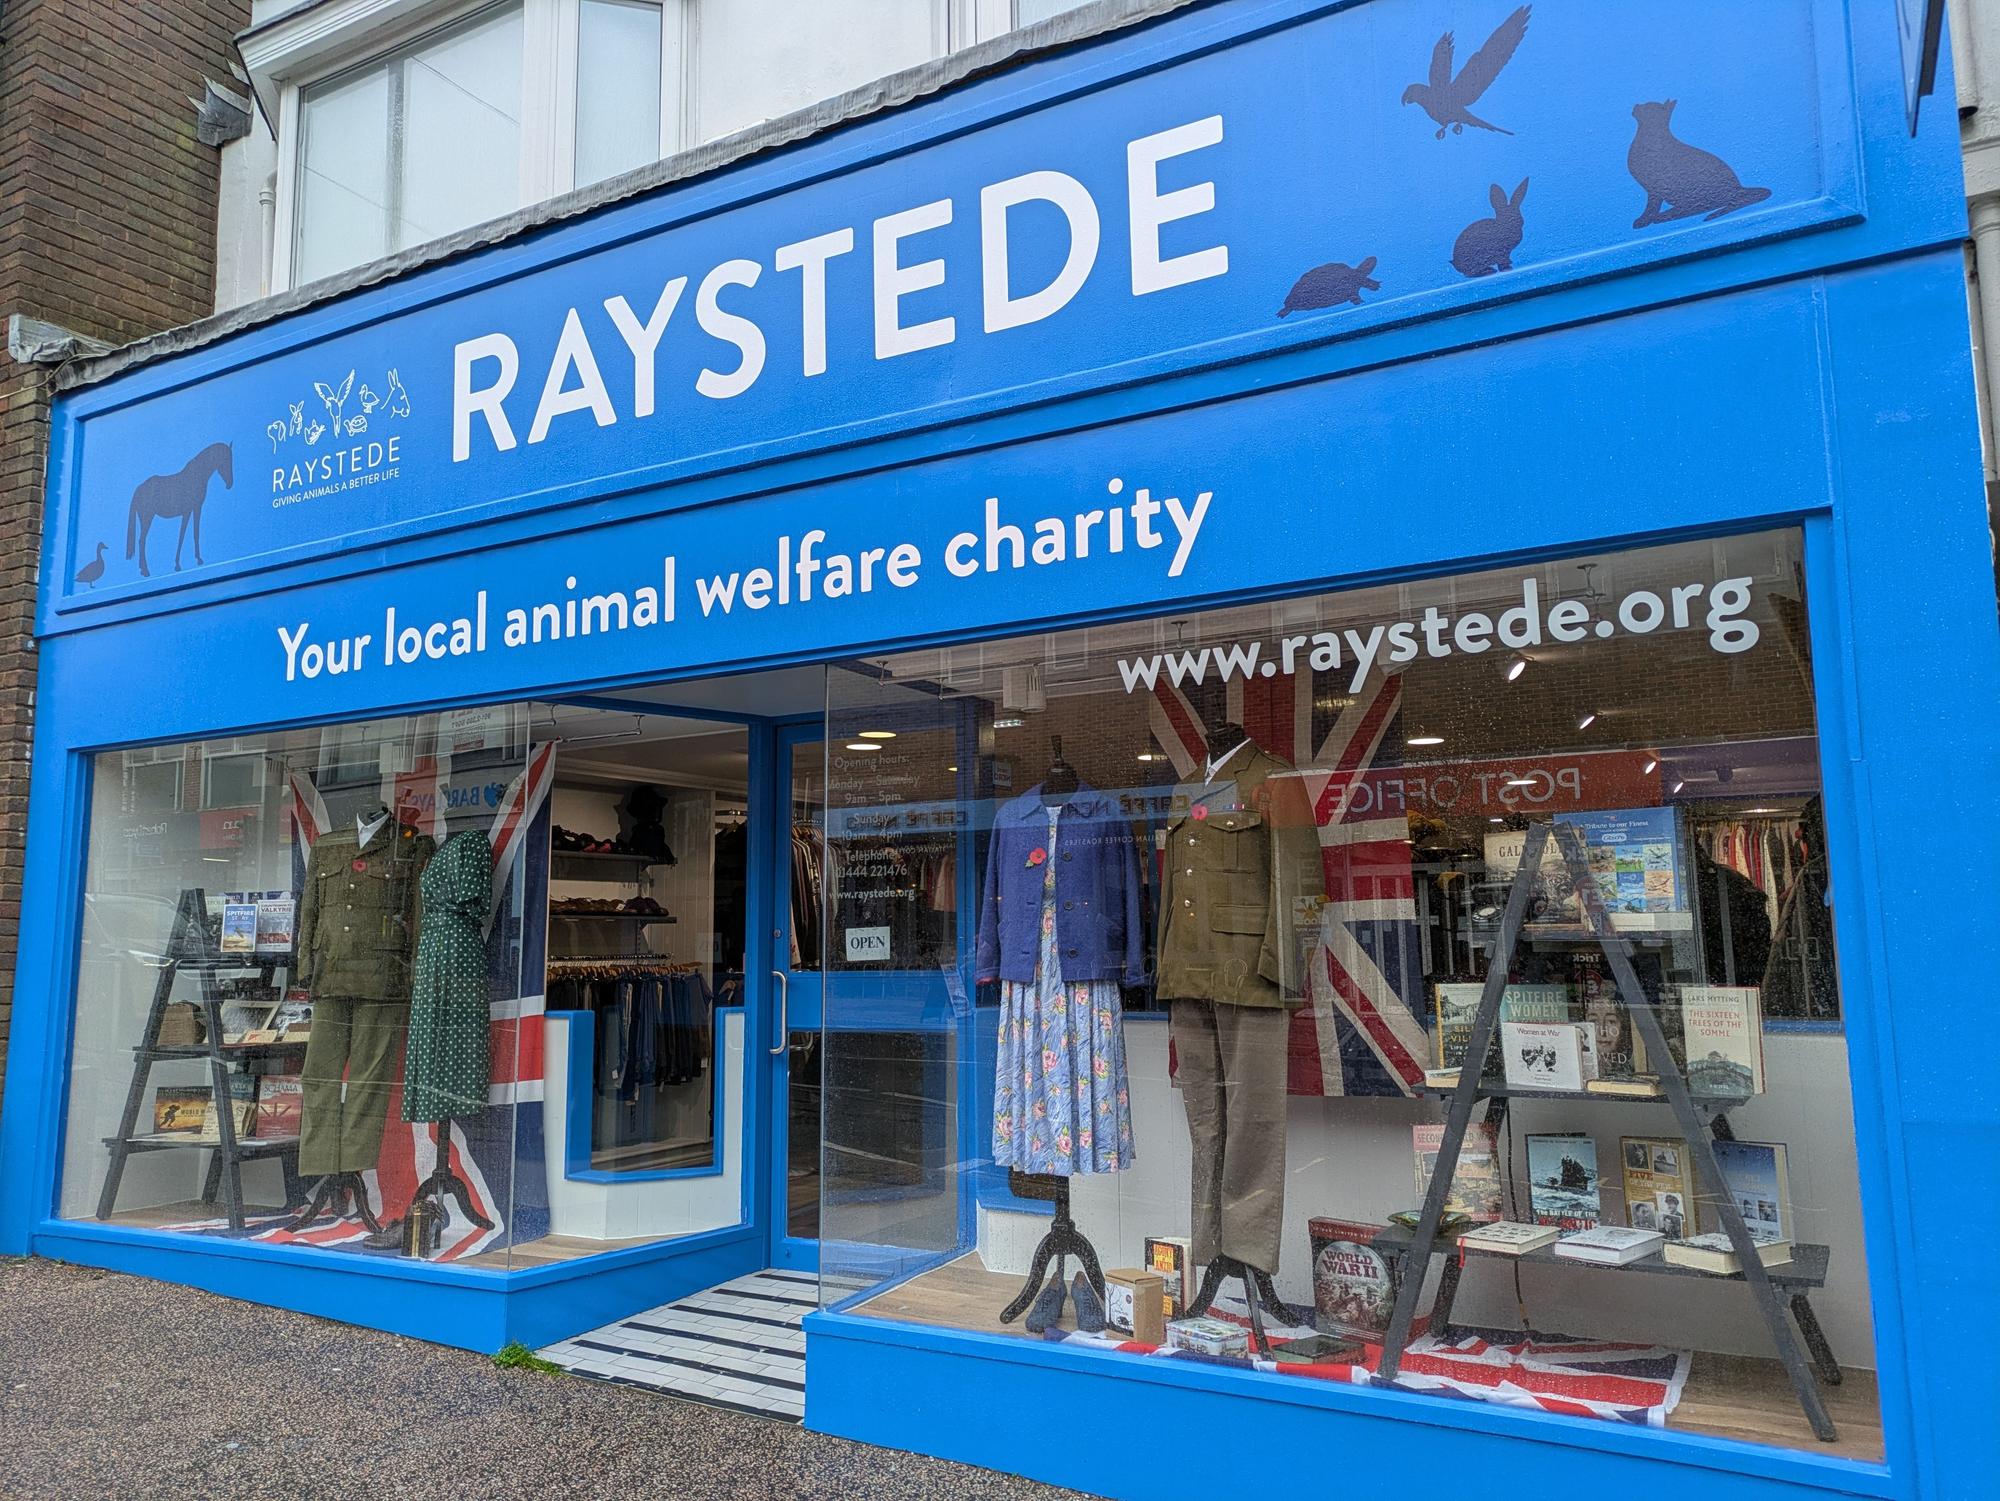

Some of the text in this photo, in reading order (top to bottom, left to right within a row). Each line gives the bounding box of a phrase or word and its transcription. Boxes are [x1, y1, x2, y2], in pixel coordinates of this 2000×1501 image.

[453, 115, 1229, 462] RAYSTEDE
[273, 436, 400, 492] RAYSTEDE
[272, 468, 399, 508] GIVING ANIMALS A BETTER LIFE
[278, 478, 1213, 681] Your local animal welfare charity
[1117, 577, 1760, 694] www.raystede.org
[835, 755, 911, 771] Opening hours:
[845, 793, 867, 803] 9am
[879, 791, 901, 805] 5pm
[853, 812, 890, 826] Sunday
[880, 828, 902, 843] 4pm
[871, 864, 907, 877] 221476
[829, 886, 915, 902] www.raystede.org
[850, 936, 886, 950] OPEN
[1504, 991, 1562, 1004] SPITFIRE
[1707, 995, 1740, 1003] MYTTING
[1511, 1004, 1559, 1017] WOMEN
[1690, 1010, 1740, 1019] THE SIXTEEN
[1689, 1019, 1742, 1029] TREES OF THE
[1517, 1027, 1540, 1036] Women
[1547, 1029, 1561, 1037] War
[1700, 1029, 1730, 1038] SOMME
[264, 1083, 298, 1093] SCHAMA
[1417, 1132, 1444, 1144] SECON
[1630, 1170, 1653, 1181] FIVE
[1549, 1209, 1572, 1217] BATTLE
[1574, 1210, 1583, 1218] OF
[1325, 1250, 1373, 1265] WORLD
[1322, 1260, 1379, 1279] WAR II
